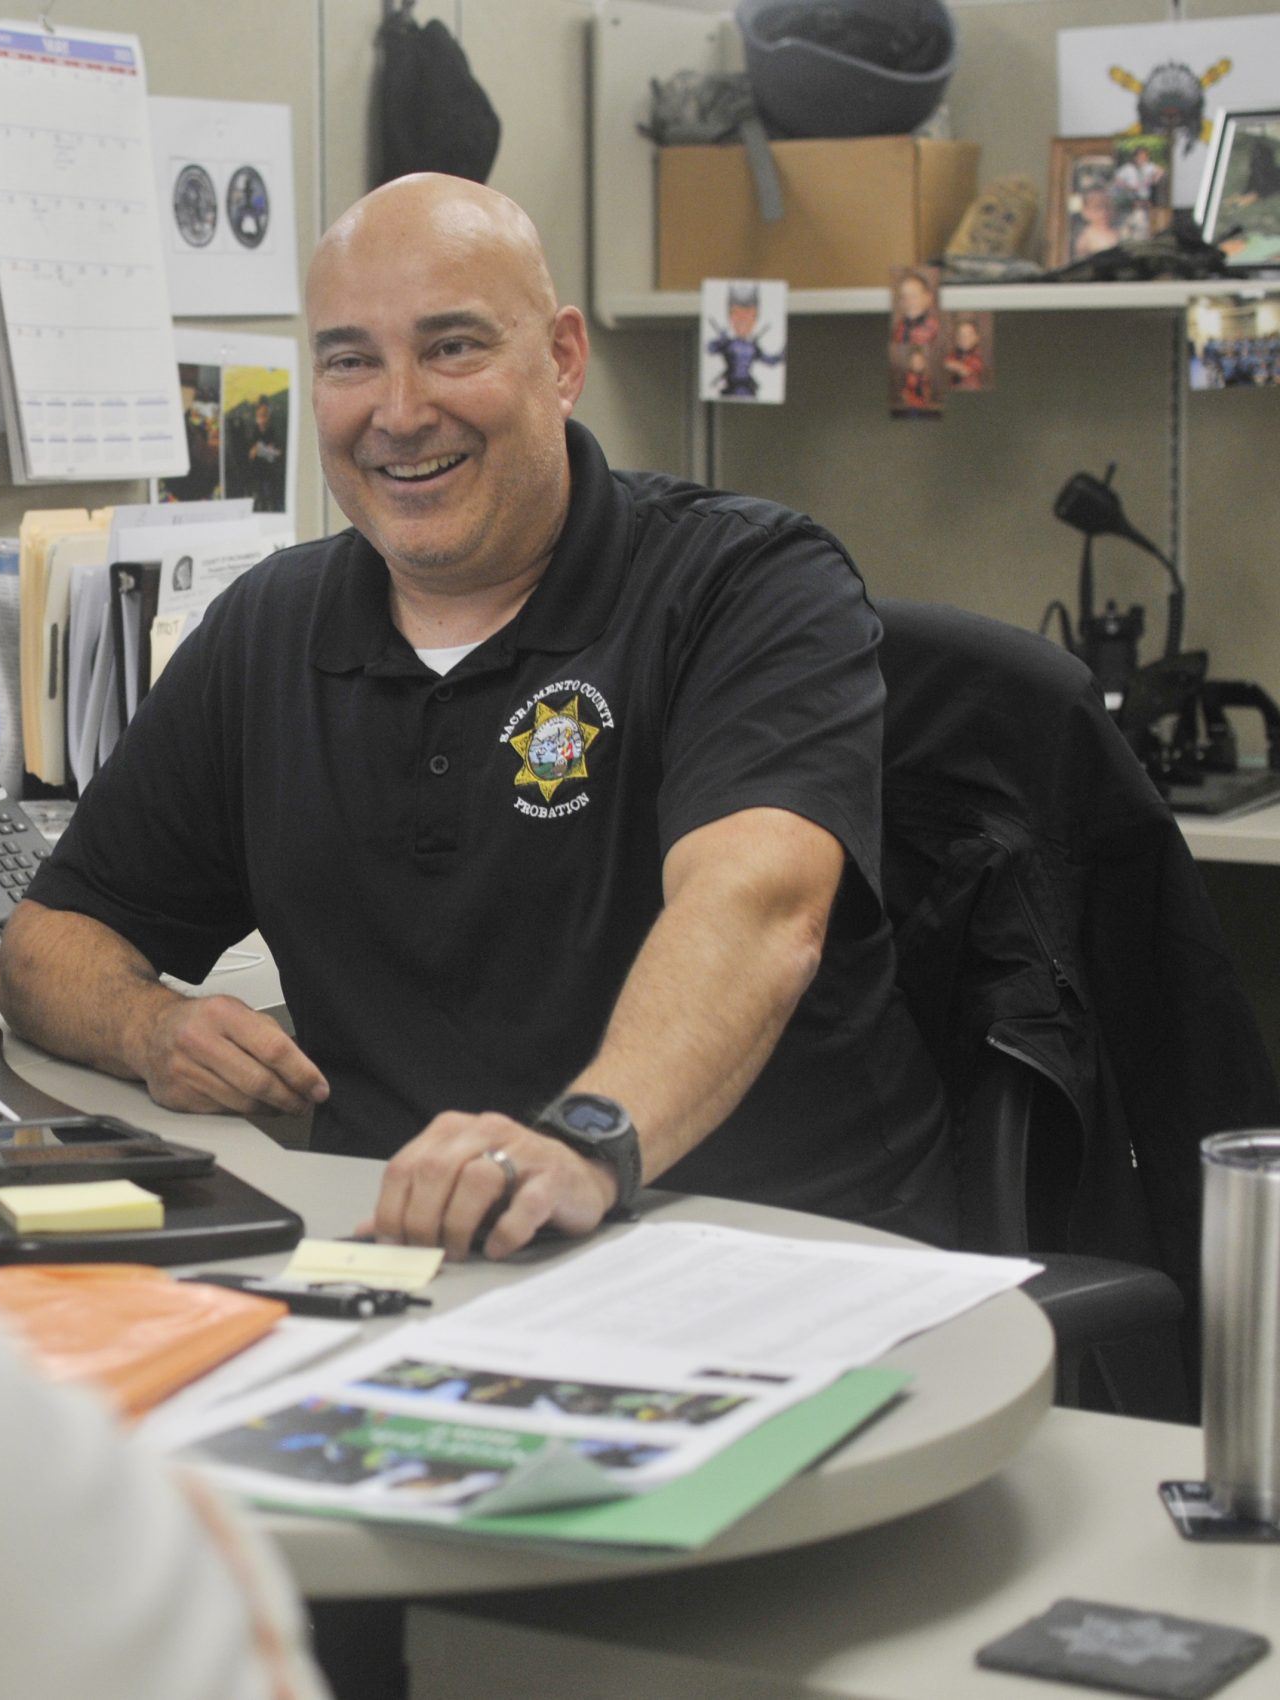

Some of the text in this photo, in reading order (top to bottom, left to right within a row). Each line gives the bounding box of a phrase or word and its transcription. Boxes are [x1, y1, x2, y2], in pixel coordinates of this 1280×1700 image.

[499, 679, 581, 744] SACRAMENTO
[579, 681, 616, 729] COUNTY
[513, 791, 591, 819] PROBATION
